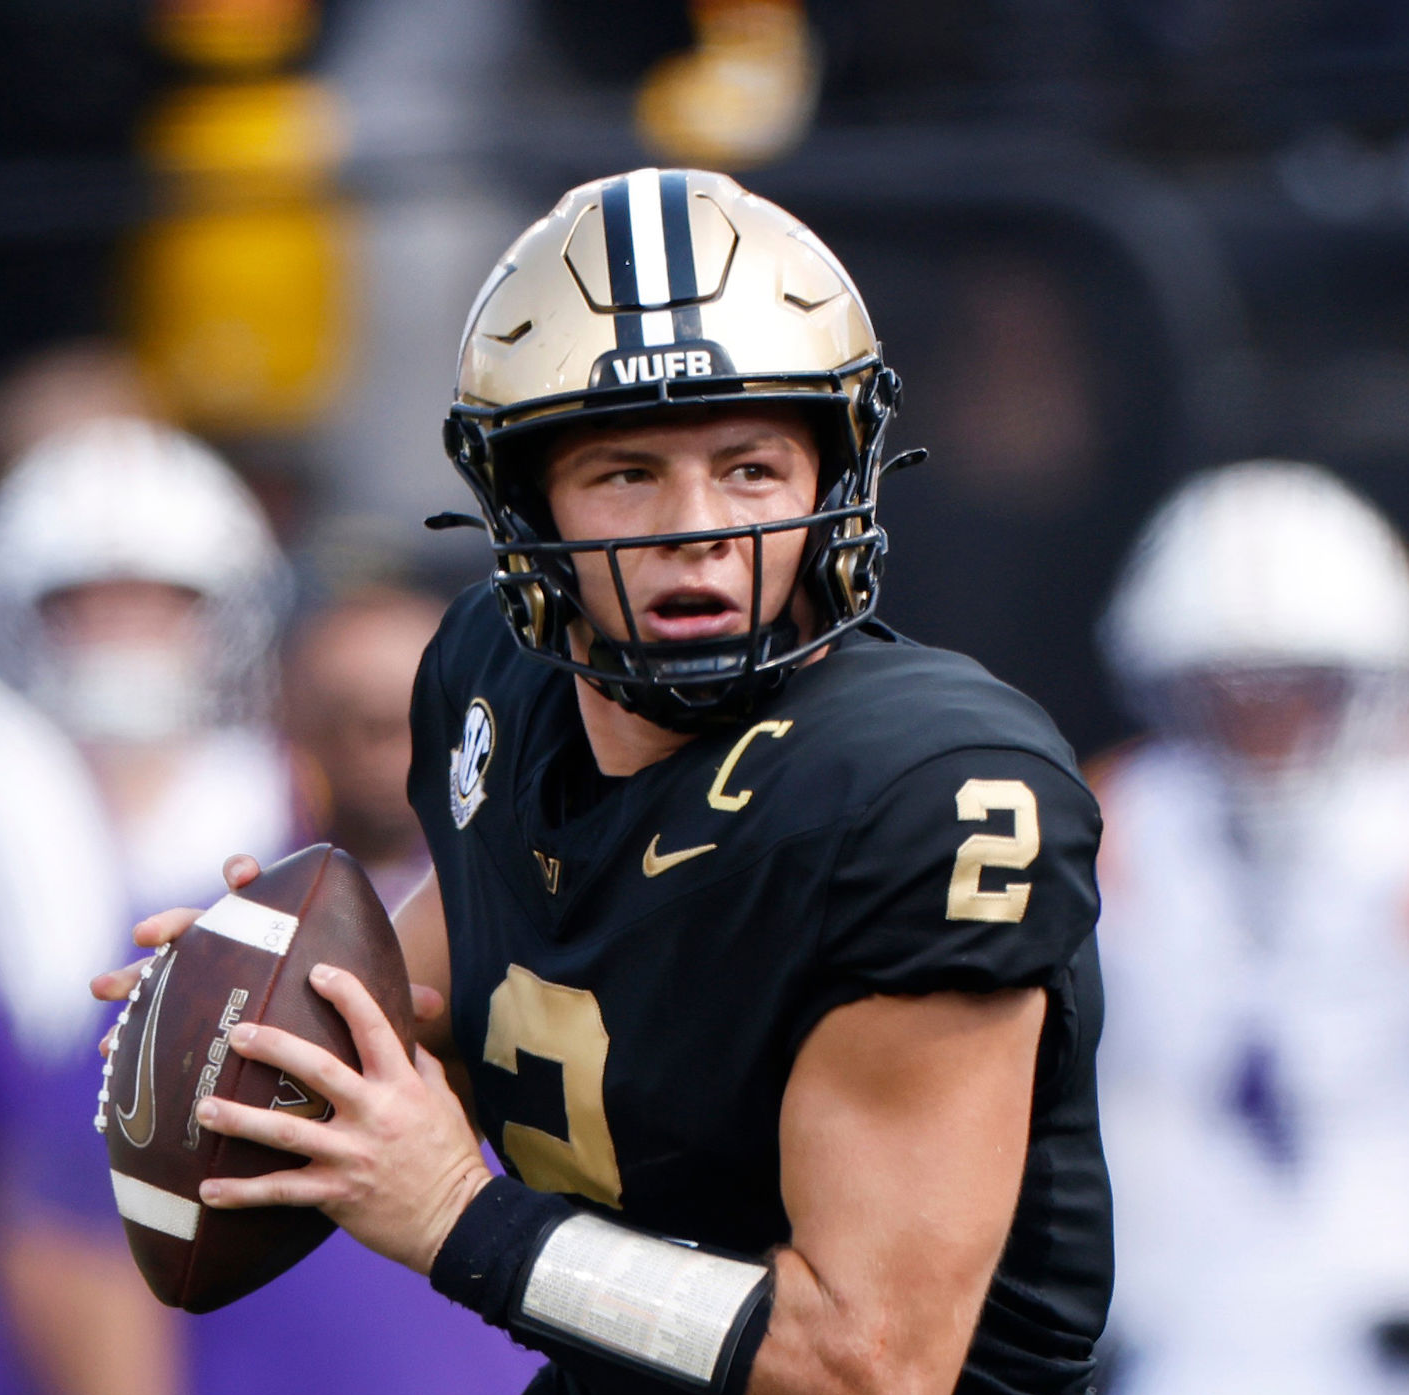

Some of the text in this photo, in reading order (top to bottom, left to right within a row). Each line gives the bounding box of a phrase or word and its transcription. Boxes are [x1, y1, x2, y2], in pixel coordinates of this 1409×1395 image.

[612, 350, 712, 385] VUFB
[707, 719, 794, 812] C
[532, 849, 561, 895] V
[945, 770, 1041, 924] 2
[483, 962, 624, 1211] 2
